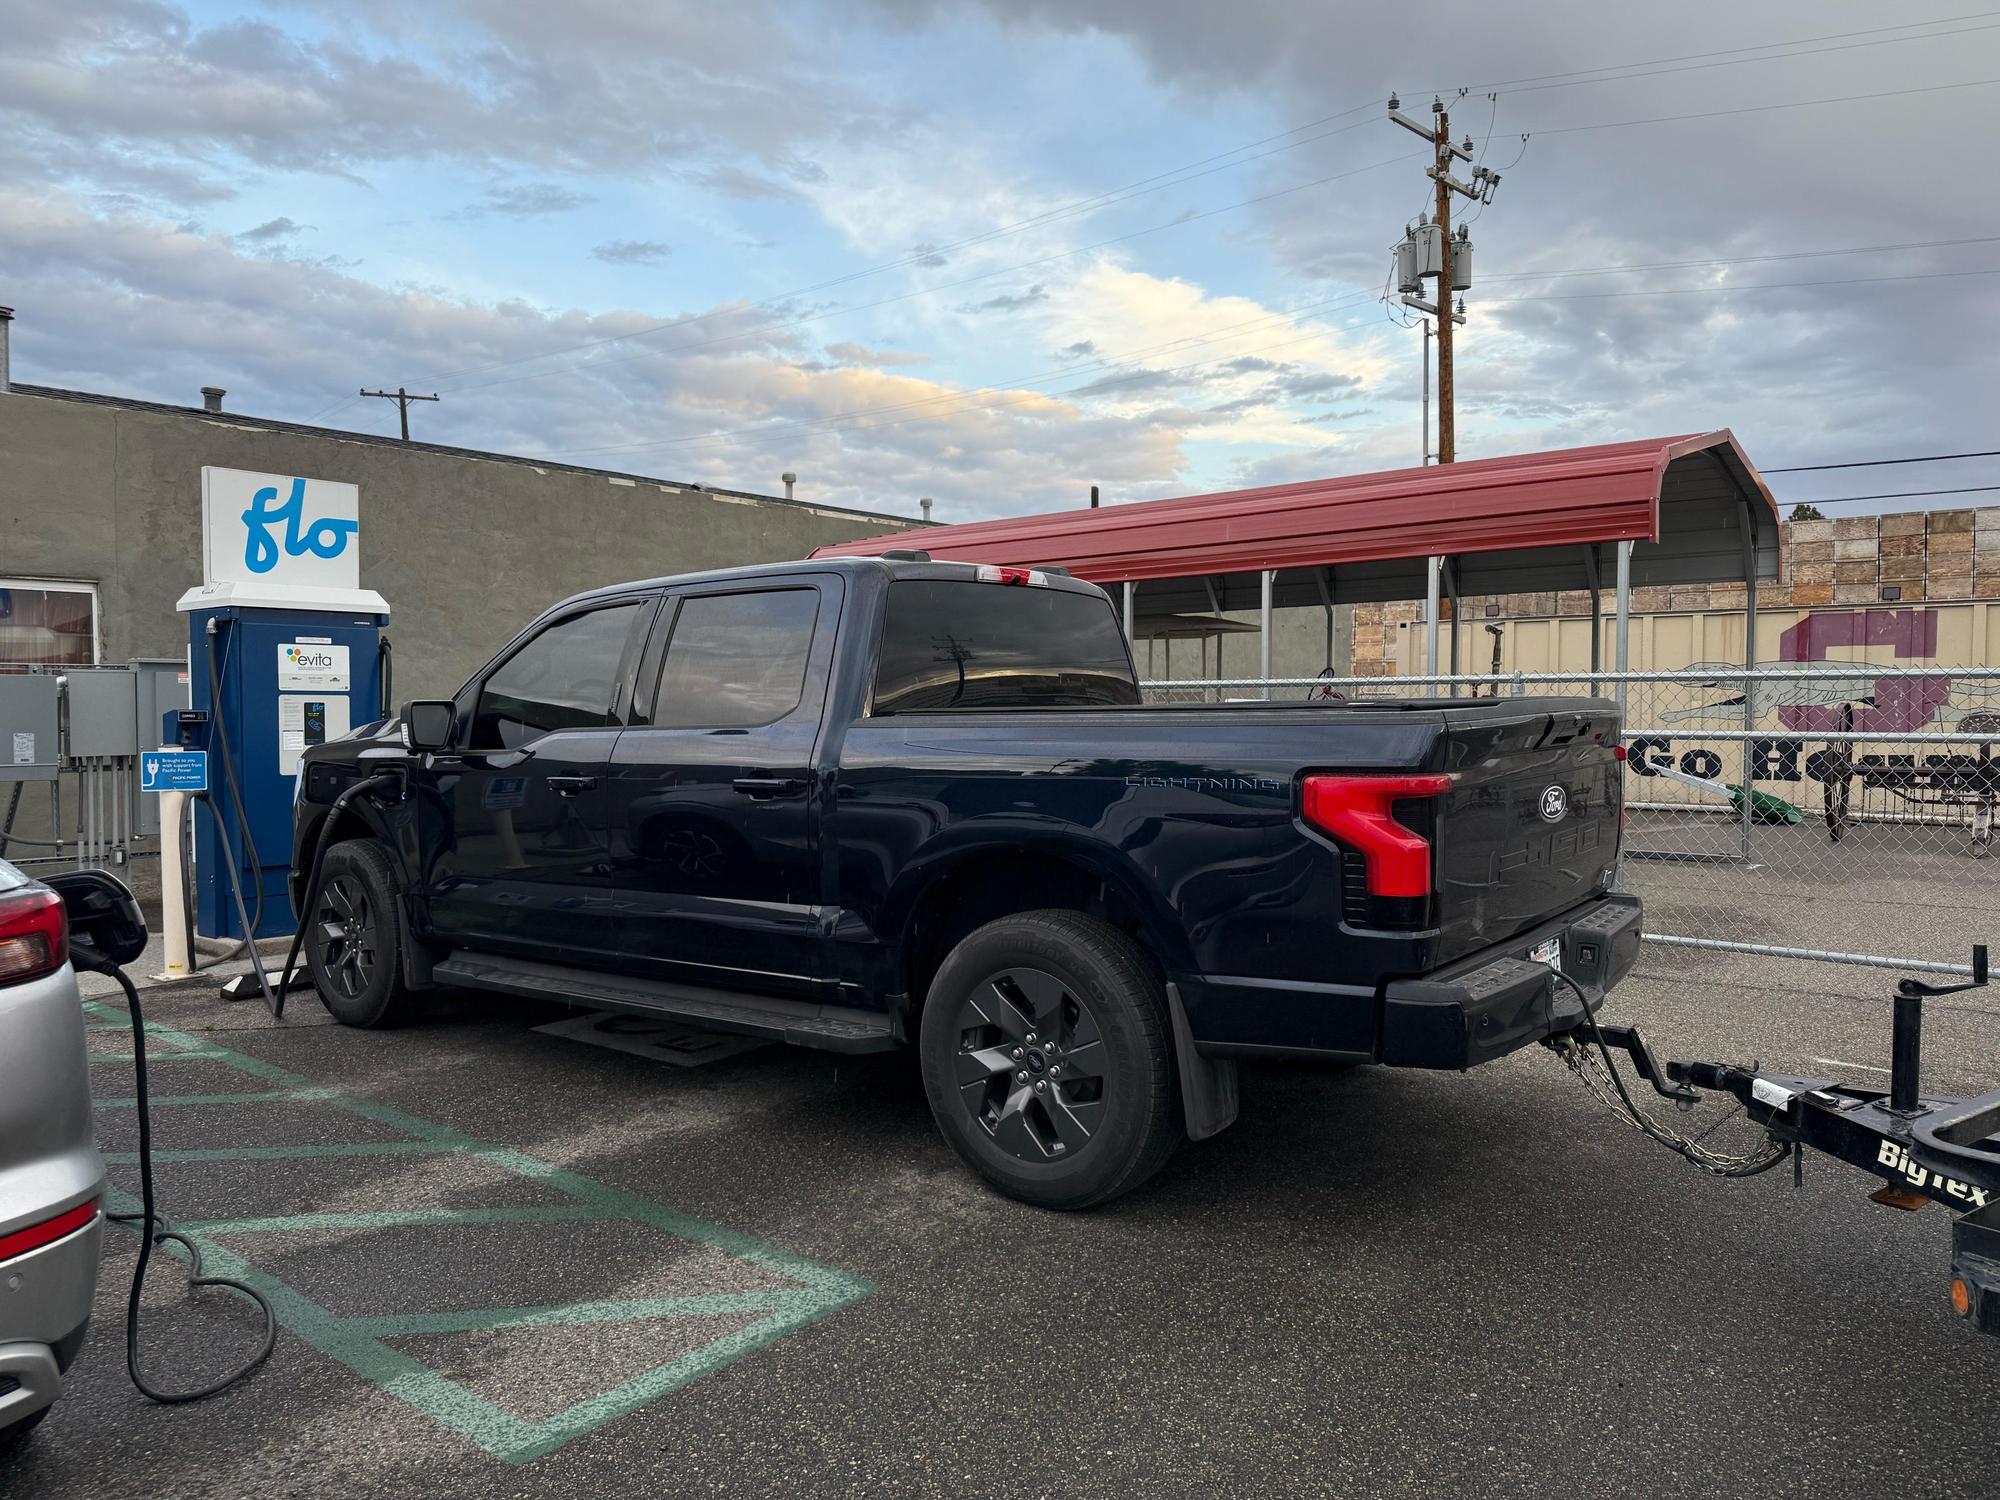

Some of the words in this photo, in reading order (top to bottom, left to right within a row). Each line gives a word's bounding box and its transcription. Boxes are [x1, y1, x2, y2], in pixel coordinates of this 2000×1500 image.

[241, 478, 358, 573] flo
[298, 653, 331, 666] evita
[1627, 737, 1722, 781] Go
[1124, 776, 1280, 793] LIGHTNING
[1877, 1139, 1928, 1187] Big
